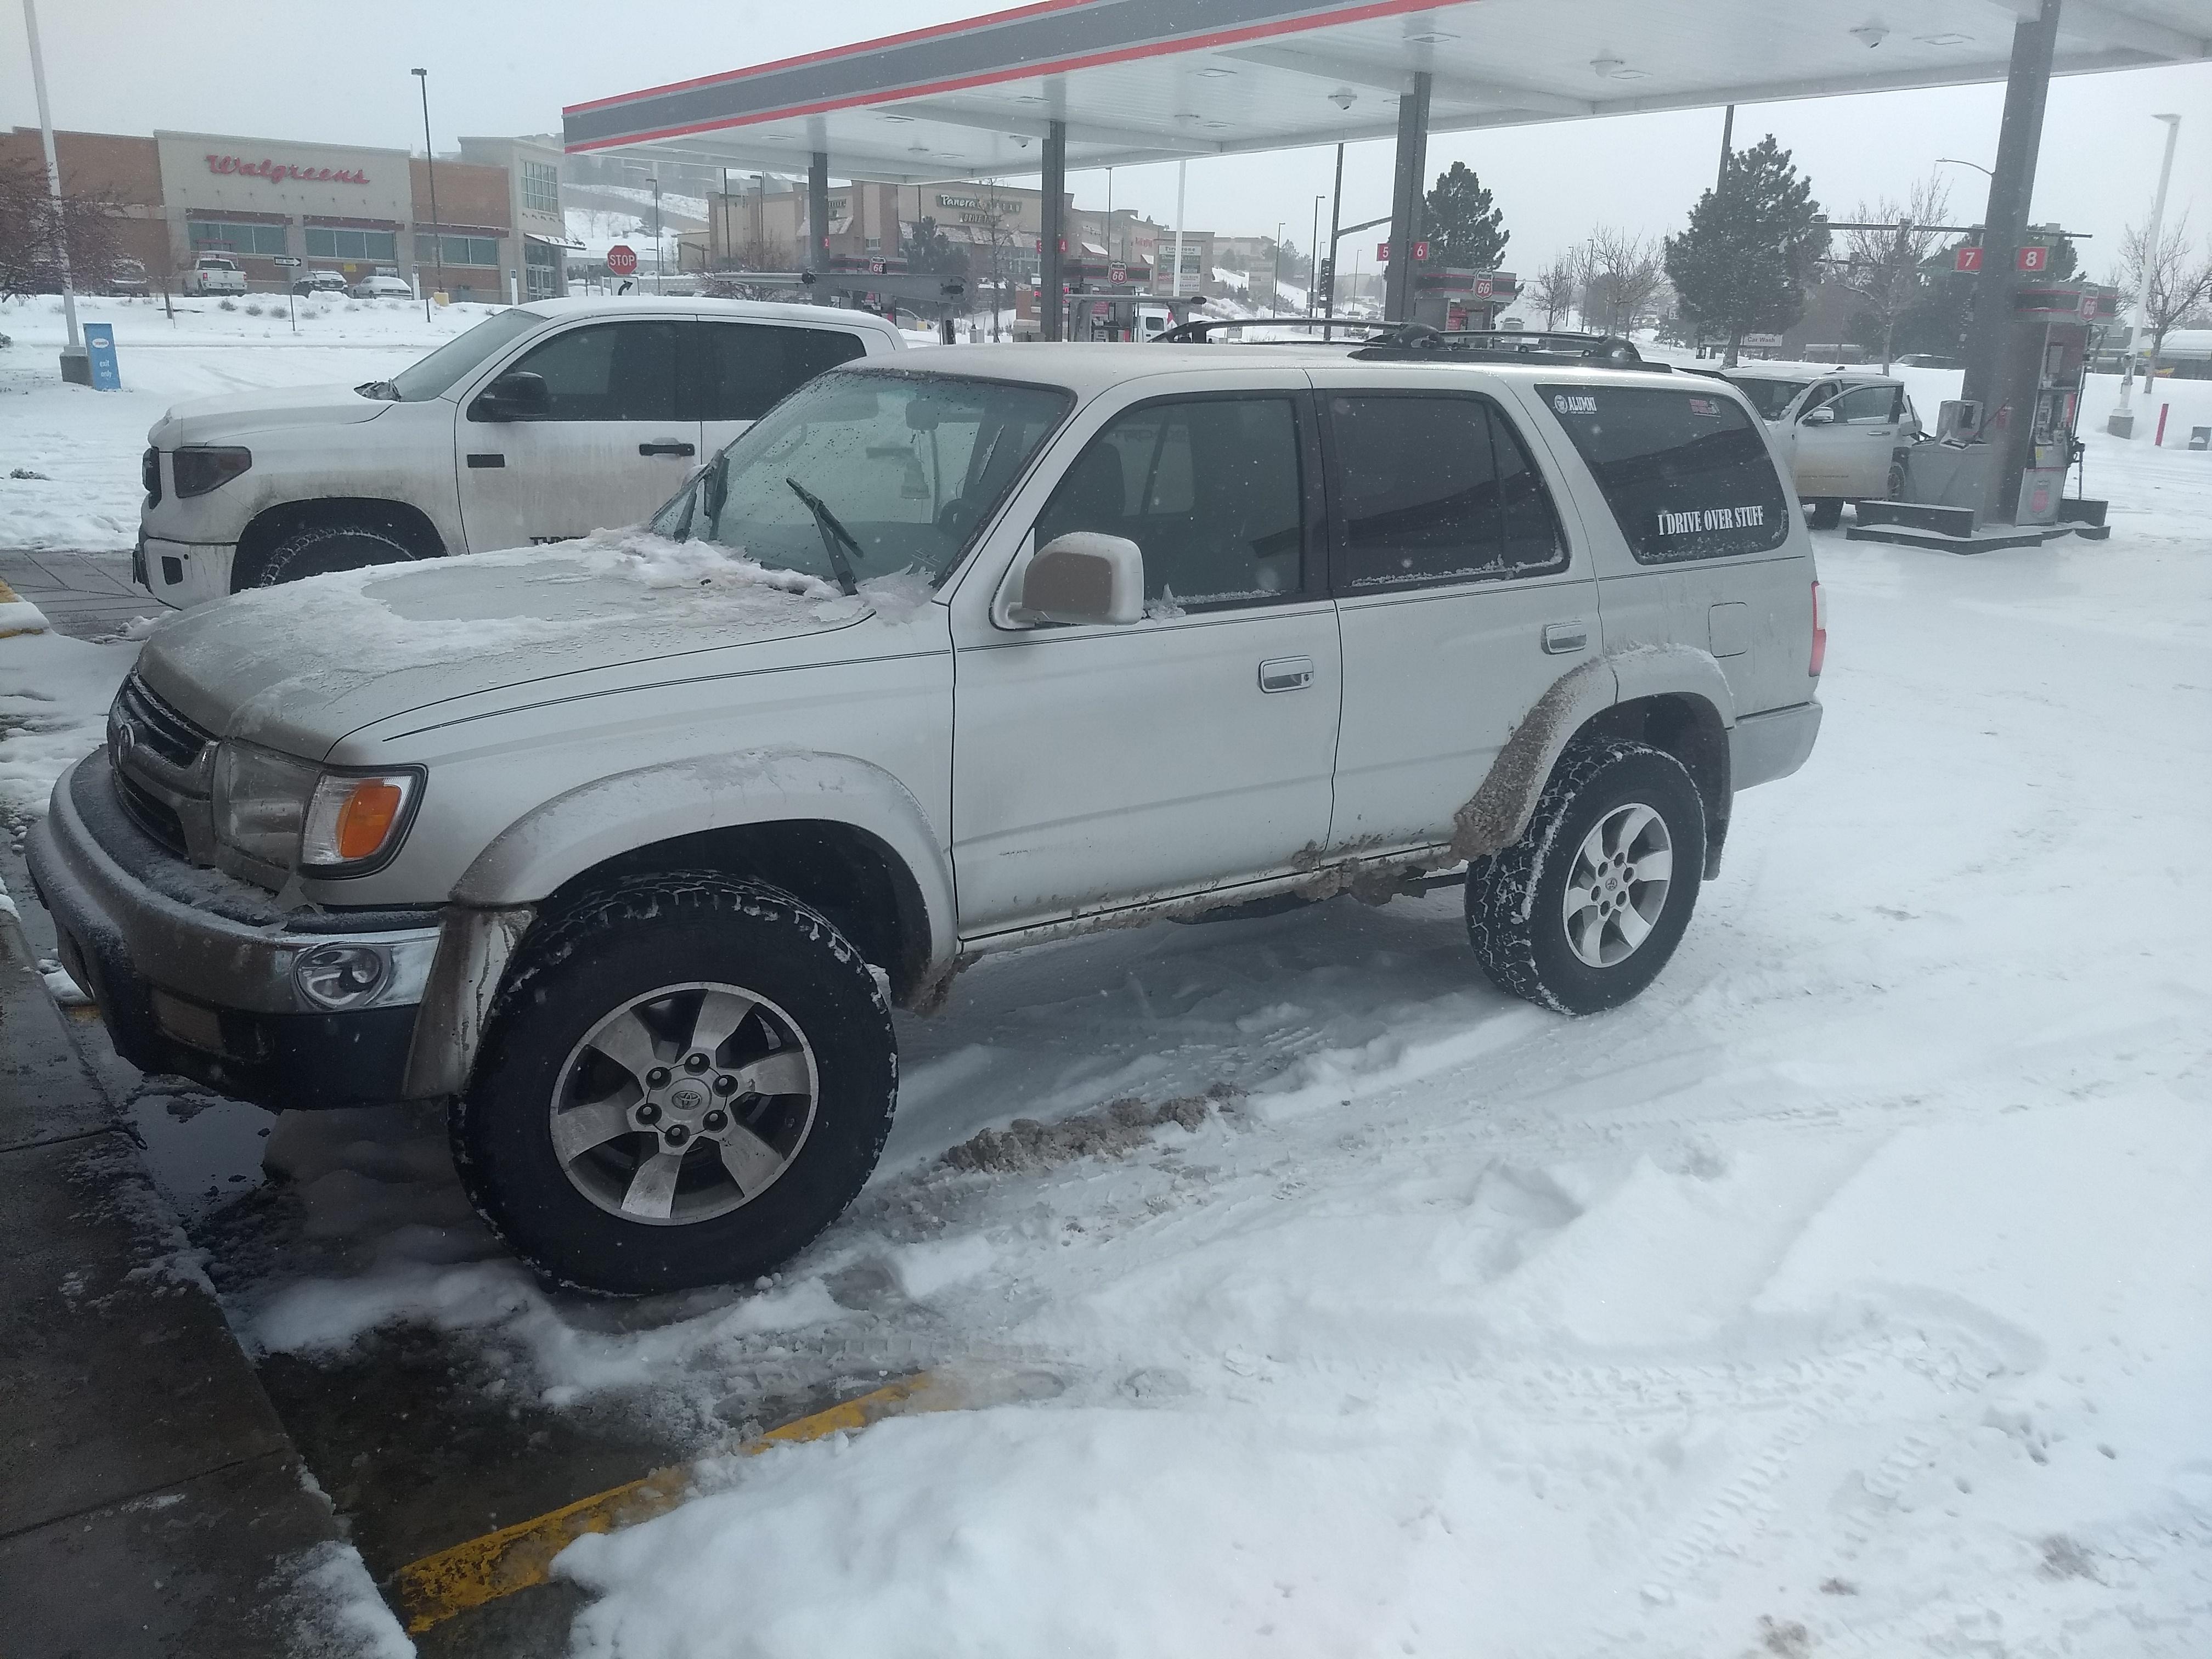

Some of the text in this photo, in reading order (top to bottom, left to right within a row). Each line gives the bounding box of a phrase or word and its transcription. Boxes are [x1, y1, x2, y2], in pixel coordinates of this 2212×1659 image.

[206, 155, 371, 184] Walgreens
[940, 194, 975, 208] Panera
[825, 238, 828, 246] 2
[1061, 241, 1065, 251] 4
[1383, 247, 1389, 258] 5
[1417, 245, 1423, 257] 6
[610, 255, 635, 266] STOP
[1965, 252, 1975, 267] 7
[2025, 251, 2037, 267] 8
[873, 264, 883, 272] 66
[1113, 271, 1124, 281] 66
[1478, 283, 1490, 294] 66
[1567, 397, 1597, 411] ALUMNI
[1657, 505, 1764, 535] I DRIVE OVER STUFF
